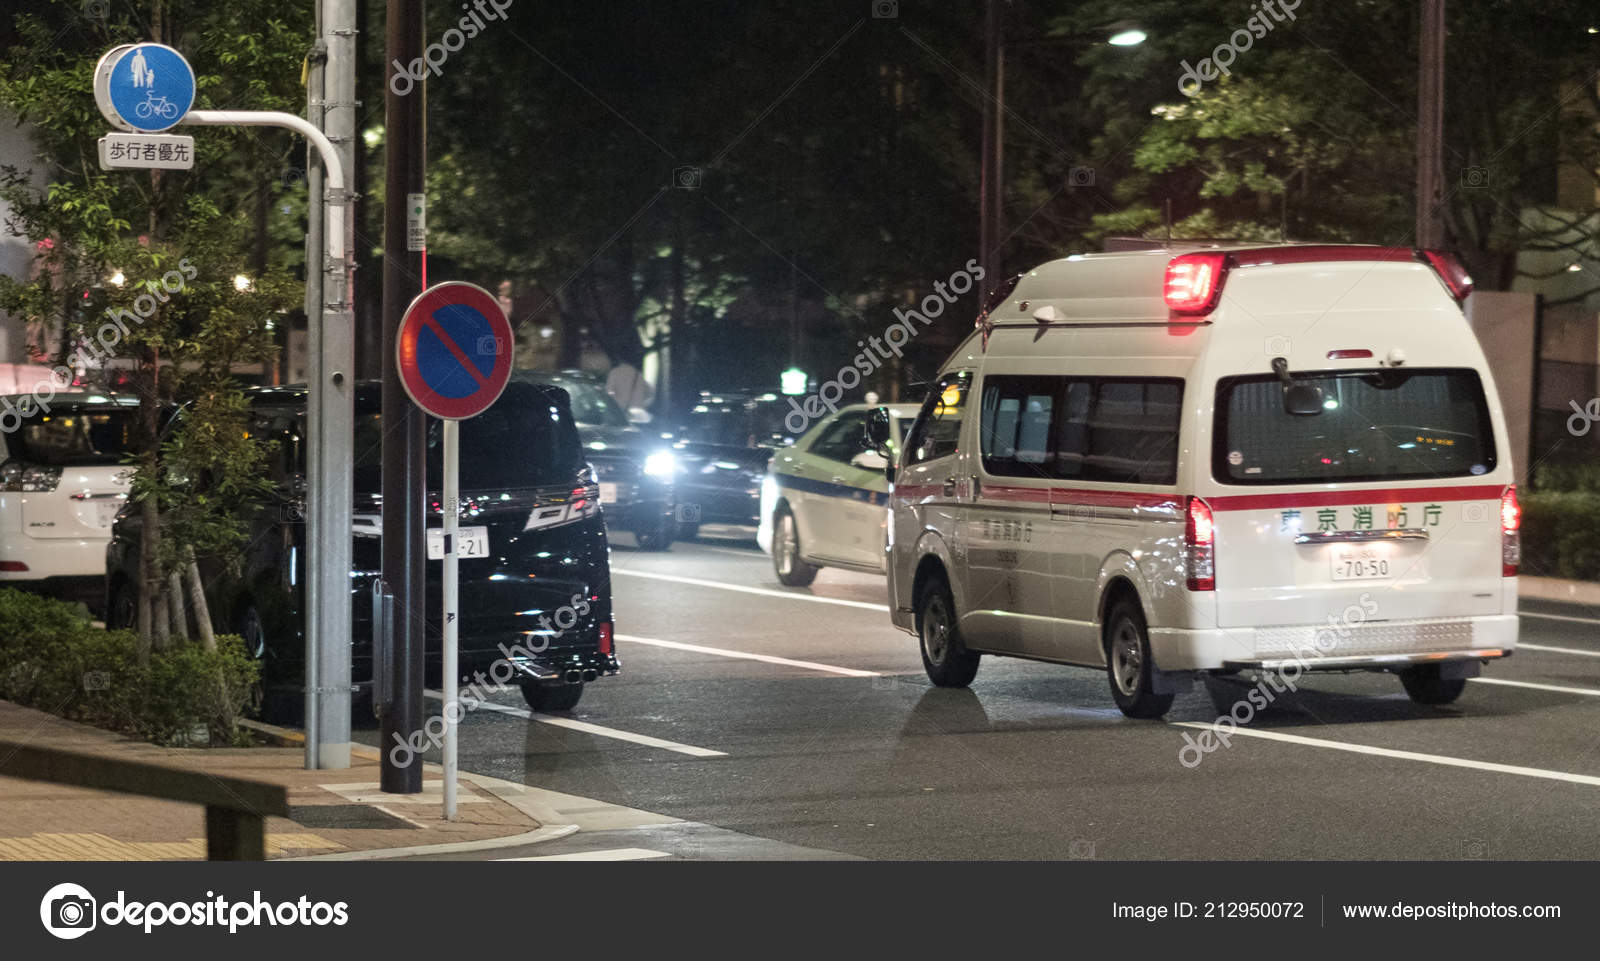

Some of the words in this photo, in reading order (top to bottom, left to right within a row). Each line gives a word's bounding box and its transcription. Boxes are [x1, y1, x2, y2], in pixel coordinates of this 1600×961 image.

[110, 142, 189, 162] 歩行者優先
